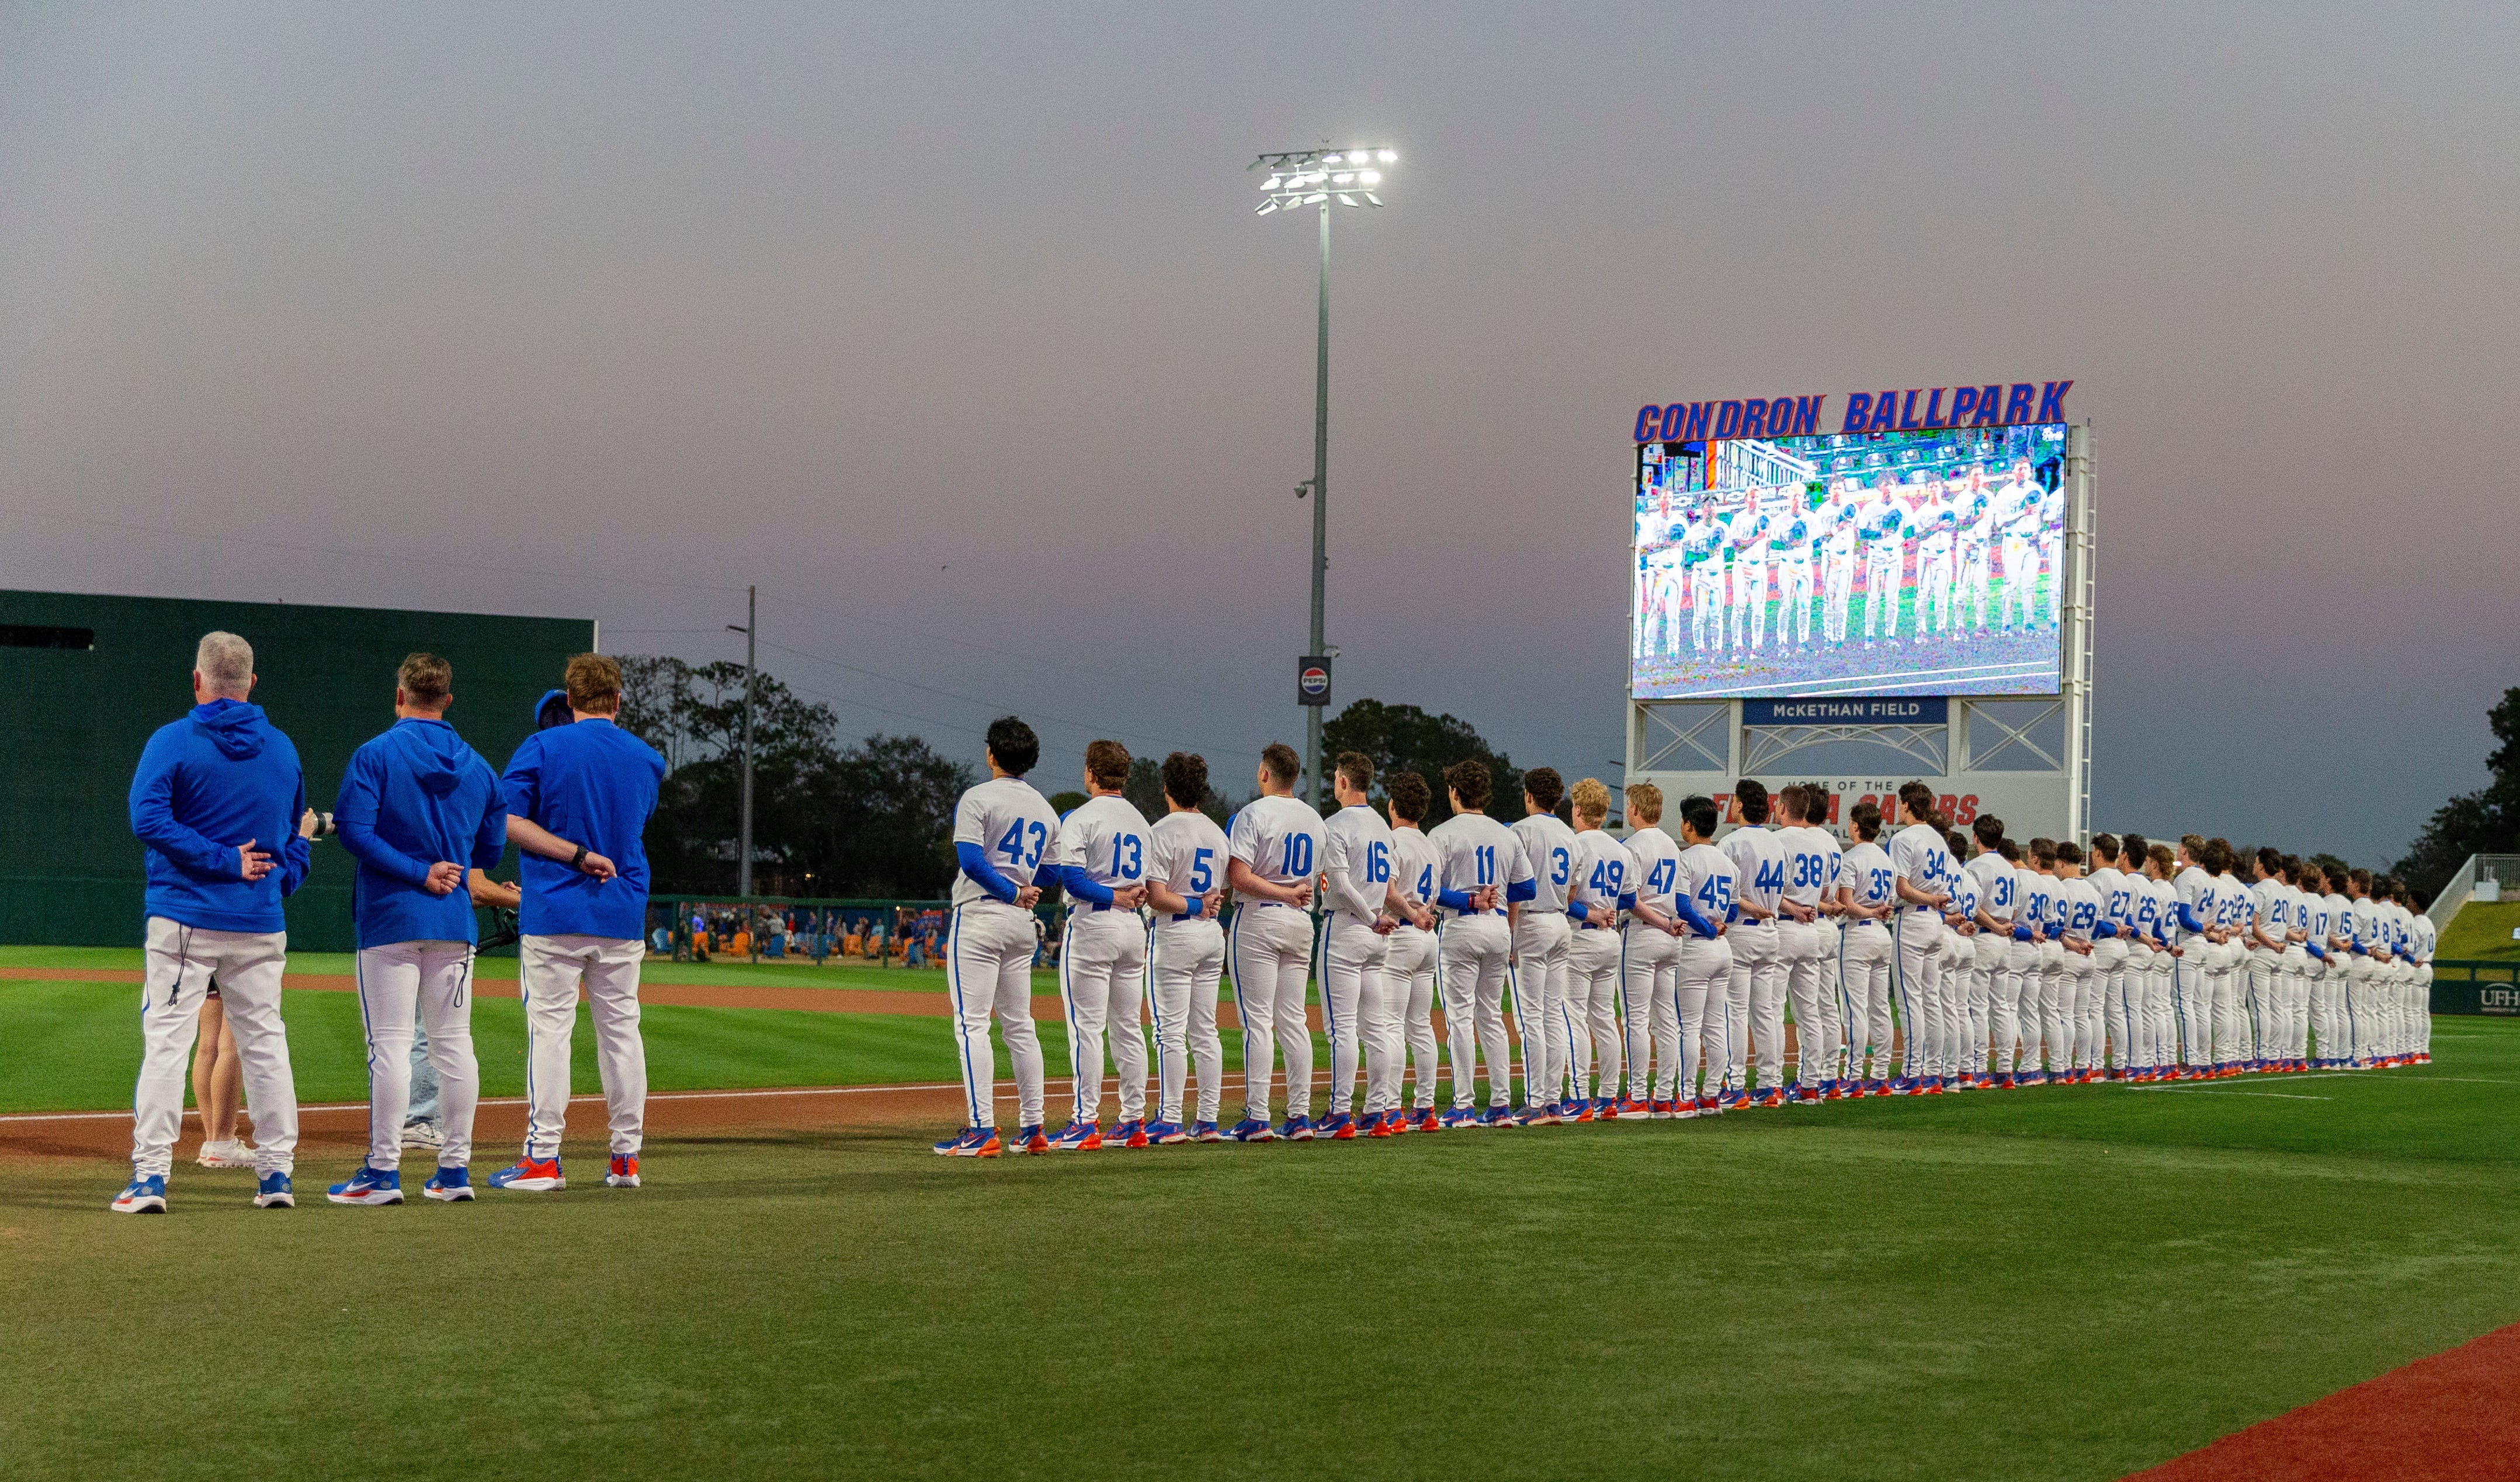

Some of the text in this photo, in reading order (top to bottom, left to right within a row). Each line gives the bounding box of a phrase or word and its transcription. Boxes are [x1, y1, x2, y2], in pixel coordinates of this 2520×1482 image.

[1634, 380, 2074, 444] CONDRON BALLPARK
[1773, 703, 1920, 717] McKETHAN FIELD
[1838, 781, 1856, 791] OF
[1865, 781, 1893, 791] THE
[998, 817, 1047, 869] 43
[1110, 832, 1141, 880] 13
[1281, 832, 1313, 877] 10
[1190, 848, 1213, 893] 5
[1366, 841, 1390, 883] 16
[1476, 845, 1495, 884] 11
[1551, 847, 1570, 886] 3
[1589, 859, 1624, 897] 49
[1648, 859, 1676, 894] 47
[1754, 859, 1785, 894] 44
[1793, 853, 1824, 888] 38
[1923, 848, 1945, 881] 34
[1417, 863, 1432, 903] 4
[1698, 874, 1731, 911] 45
[1868, 868, 1892, 901] 35
[1994, 876, 2015, 906] 31
[1957, 893, 1976, 921] 2
[2071, 901, 2096, 929] 28
[2109, 890, 2130, 917] 27
[2138, 896, 2155, 922] 26
[2232, 894, 2244, 918] 2
[2272, 899, 2288, 923] 20
[2316, 912, 2328, 935] 17
[2339, 911, 2352, 934] 15
[2383, 922, 2389, 943] 8
